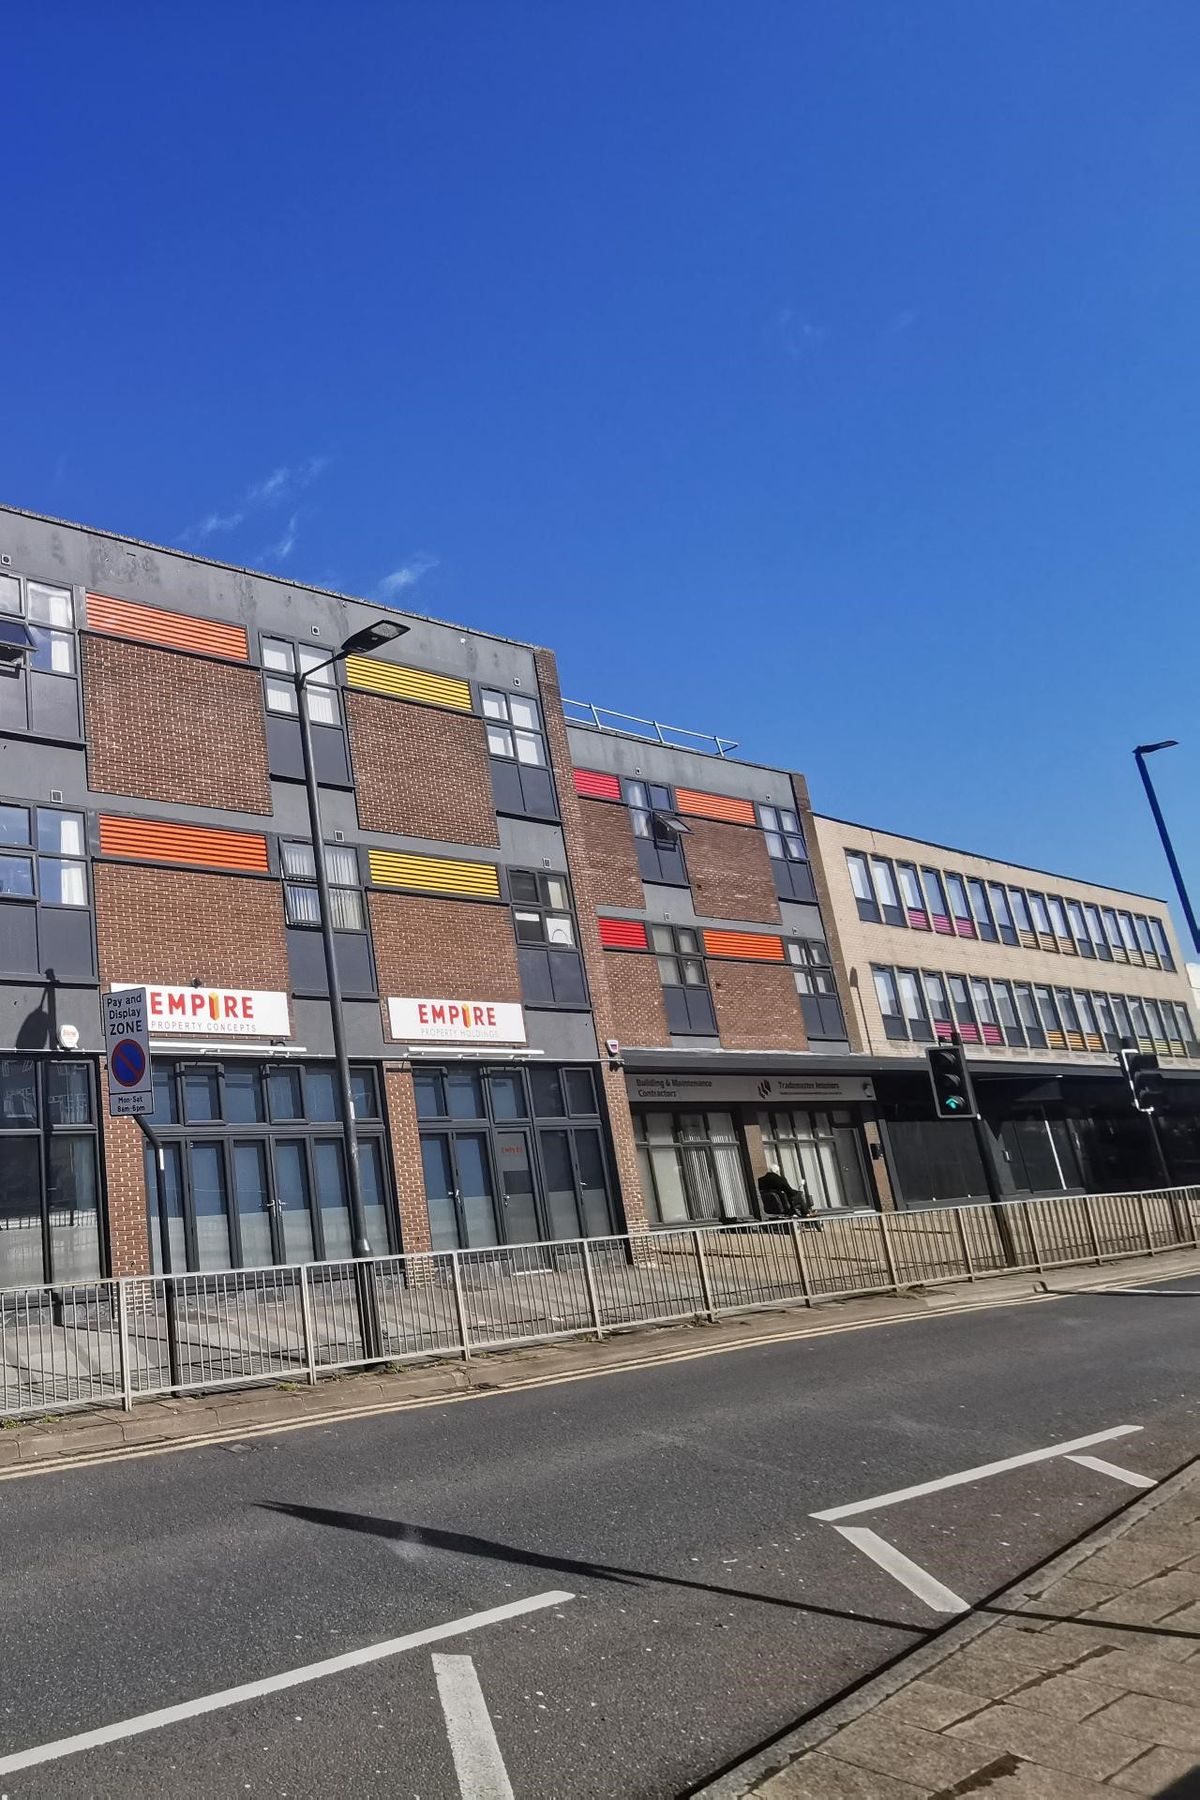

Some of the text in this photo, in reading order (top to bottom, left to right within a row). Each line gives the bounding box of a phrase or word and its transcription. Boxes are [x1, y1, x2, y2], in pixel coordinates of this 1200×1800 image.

[107, 994, 142, 1008] Pay and
[150, 991, 254, 1021] EMPIRE
[109, 1008, 141, 1021] Display
[418, 1003, 496, 1028] EMPIRE
[110, 1020, 143, 1036] ZONE
[151, 1020, 256, 1033] PROPERTY CONCEPTS
